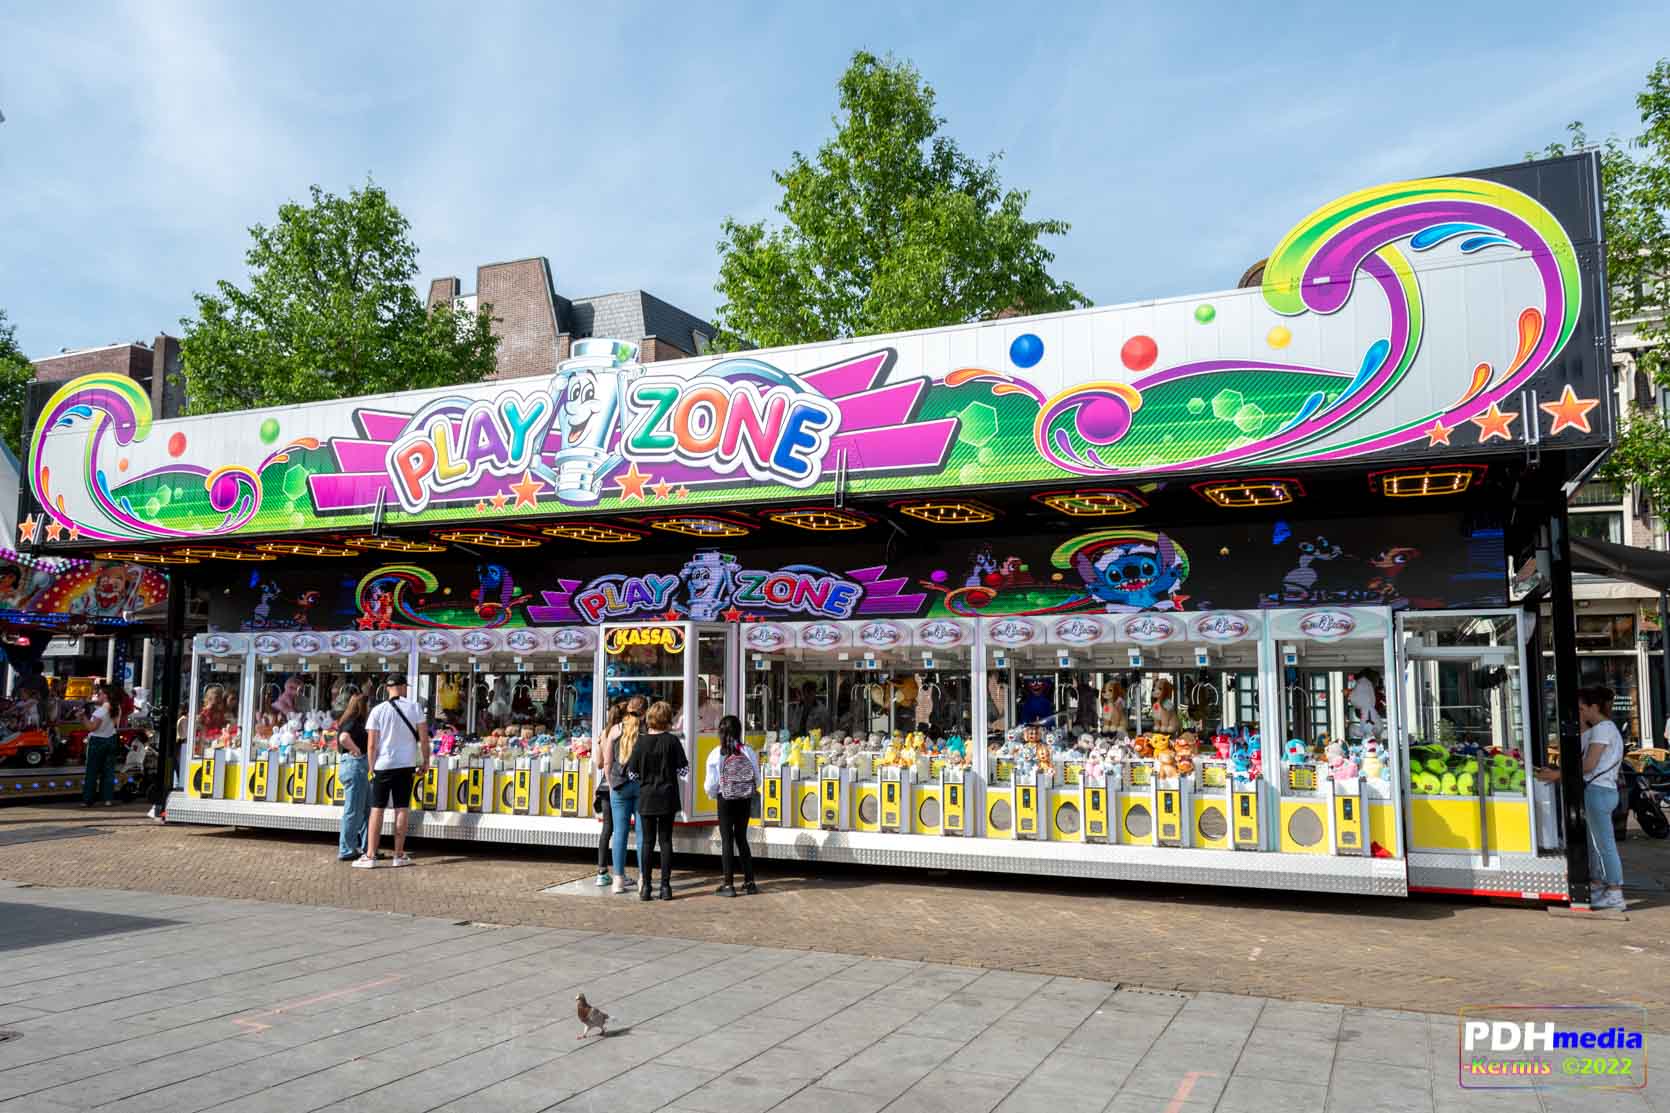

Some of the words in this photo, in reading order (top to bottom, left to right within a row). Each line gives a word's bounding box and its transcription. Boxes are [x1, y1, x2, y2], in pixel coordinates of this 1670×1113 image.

[392, 396, 549, 505] PLAY
[628, 382, 833, 478] ZONE
[583, 577, 676, 622] PLAY
[737, 573, 860, 615] ZONE
[615, 627, 674, 646] KASSA
